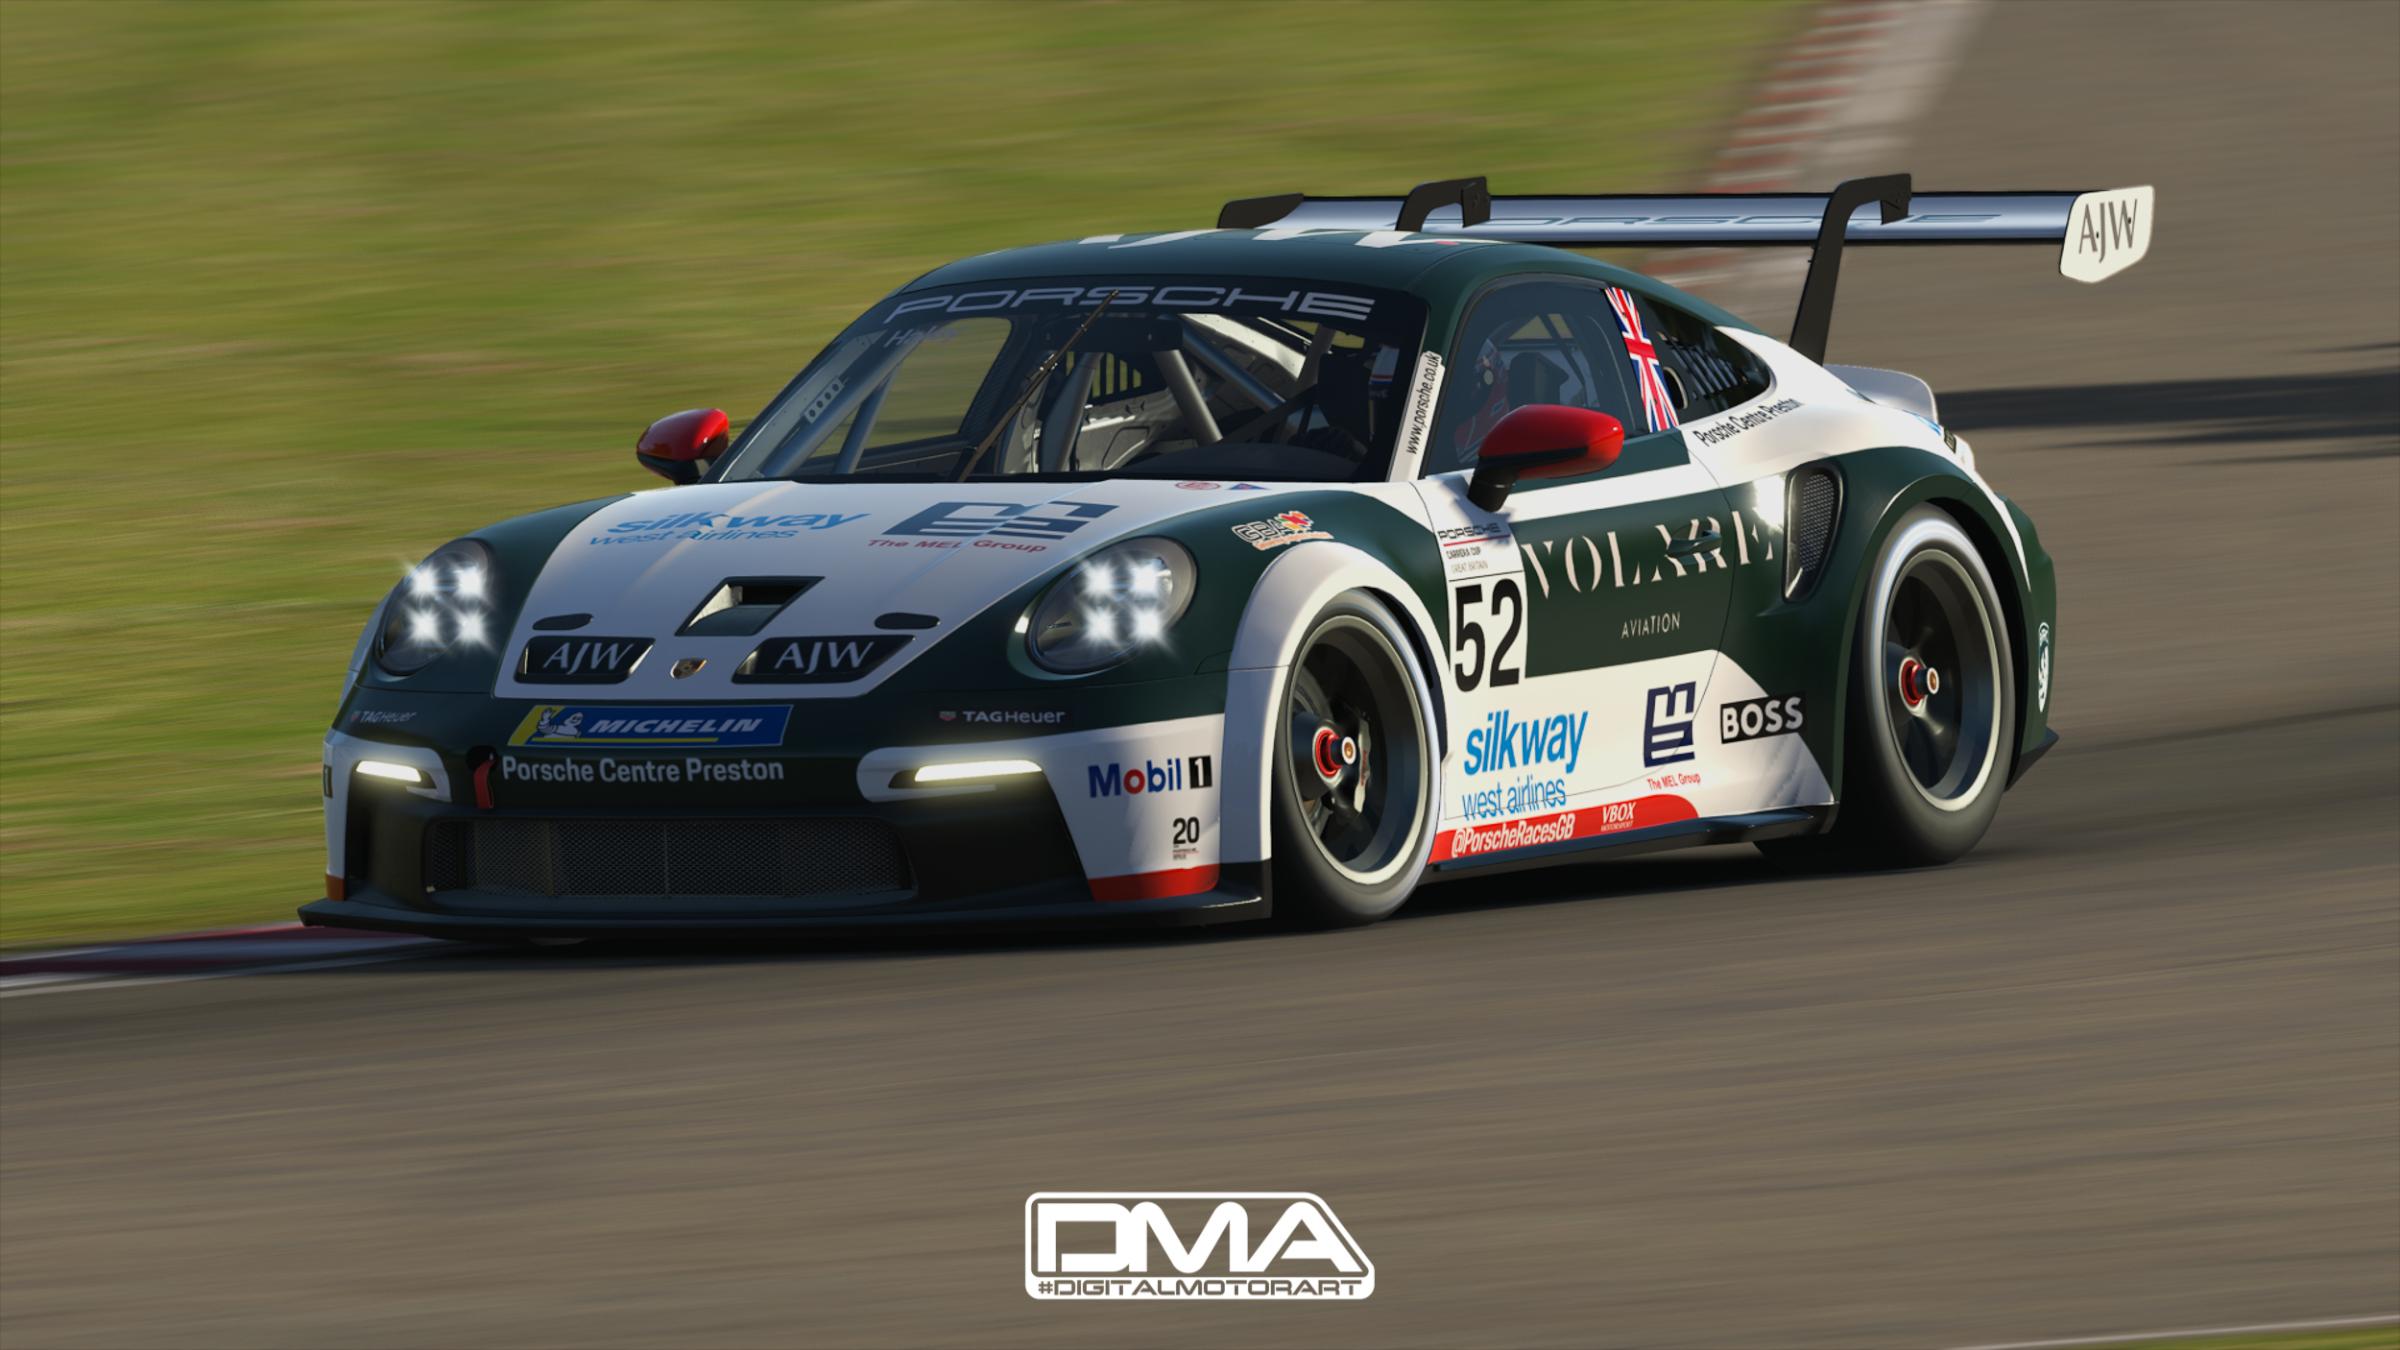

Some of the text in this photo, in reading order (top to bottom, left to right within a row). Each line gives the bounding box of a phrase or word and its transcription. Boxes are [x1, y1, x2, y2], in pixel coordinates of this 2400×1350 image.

[2077, 198, 2138, 262] AJW
[886, 285, 1375, 324] PORSCHE
[1406, 352, 1440, 455] www.porsche.co.uk
[1692, 420, 1740, 447] Porsche
[1728, 410, 1773, 430] Centre
[589, 529, 669, 546] west
[607, 511, 871, 534] silkway
[1437, 522, 1502, 539] PORSCHE
[867, 538, 910, 549] The
[973, 539, 1047, 554] Group
[1454, 577, 1524, 693] 52
[1620, 611, 1681, 639] AVIATION
[543, 642, 635, 676] AJW
[774, 640, 875, 675] AJW
[588, 717, 765, 734] MICHELIN
[1721, 696, 1804, 740] BOSS
[1463, 709, 1588, 776] silkway
[502, 756, 784, 783] Porsche Centre Preston
[1088, 757, 1182, 798] Mobil
[1462, 774, 1567, 822] west airlines
[1602, 802, 1637, 824] VBOX
[1173, 816, 1200, 845] 20
[1451, 812, 1577, 859] @PorscheRacesGB
